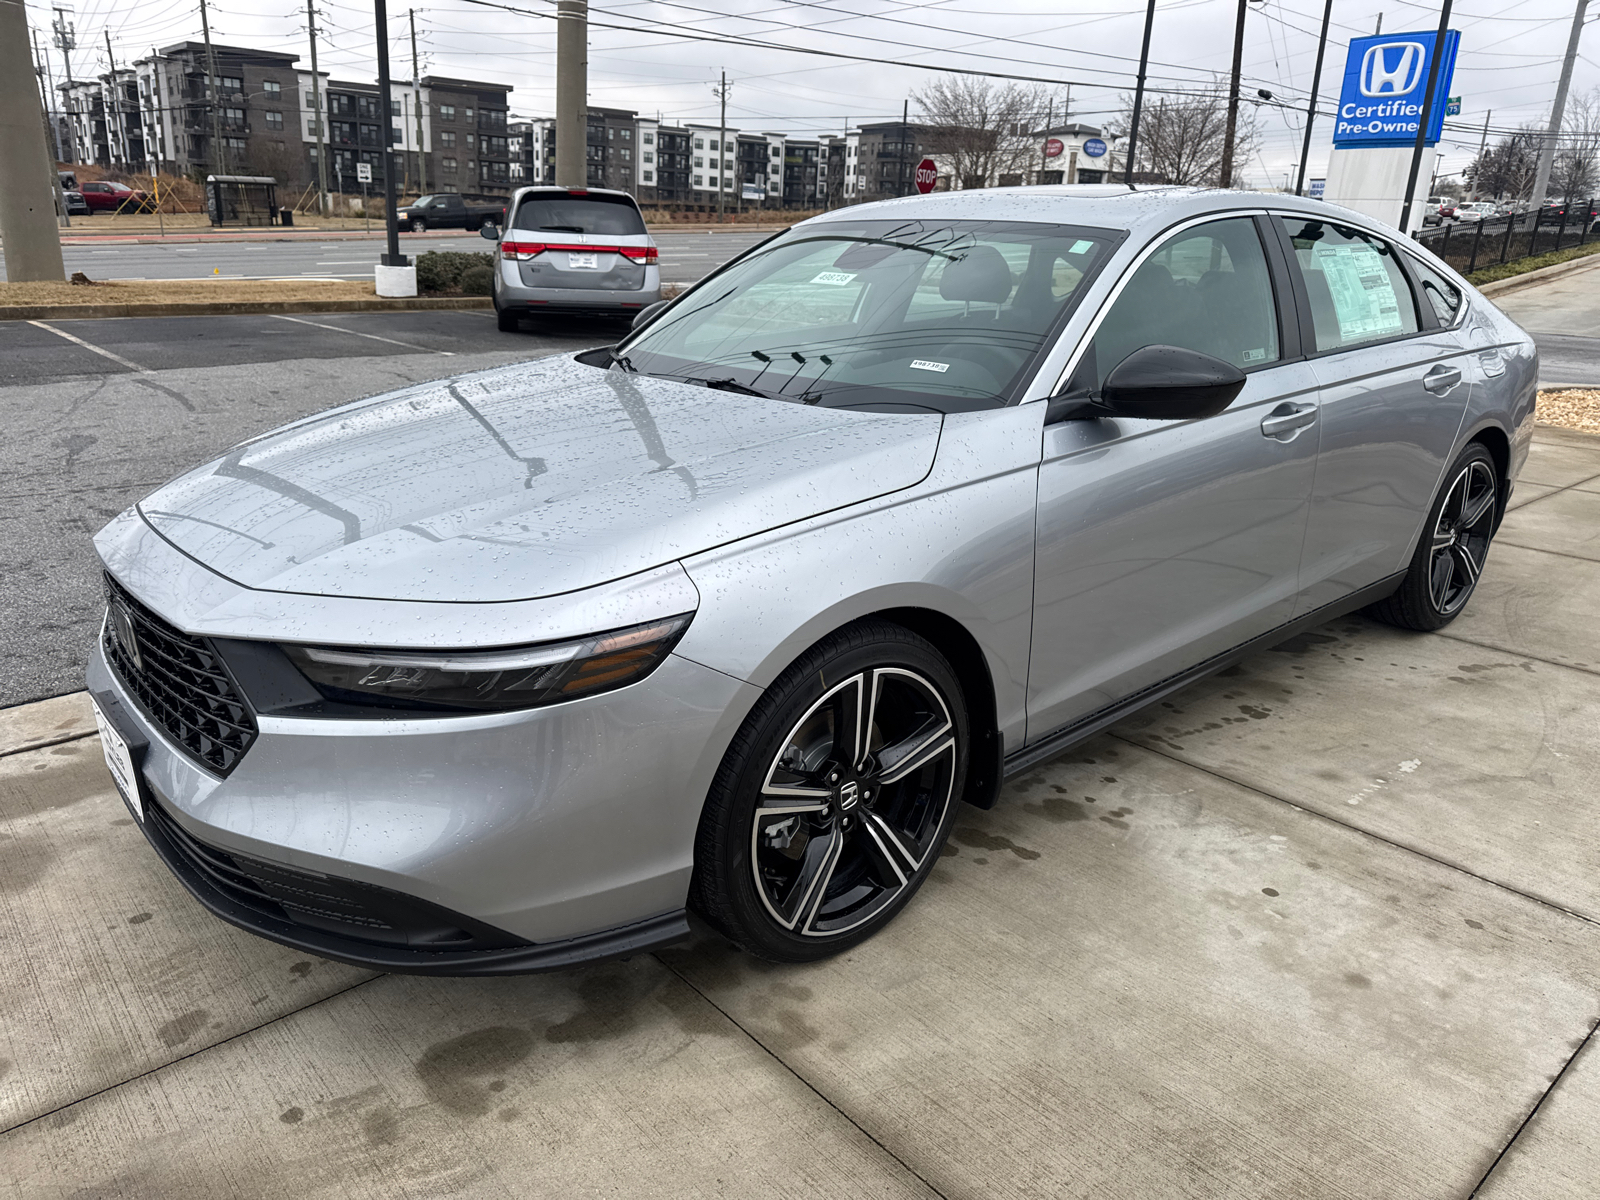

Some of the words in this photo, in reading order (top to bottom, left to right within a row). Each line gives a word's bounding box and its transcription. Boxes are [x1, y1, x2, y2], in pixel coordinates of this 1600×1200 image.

[1337, 120, 1420, 134] Pre-Owne
[917, 169, 936, 184] STOP
[818, 273, 850, 282] 498738
[912, 361, 940, 369] 498738
